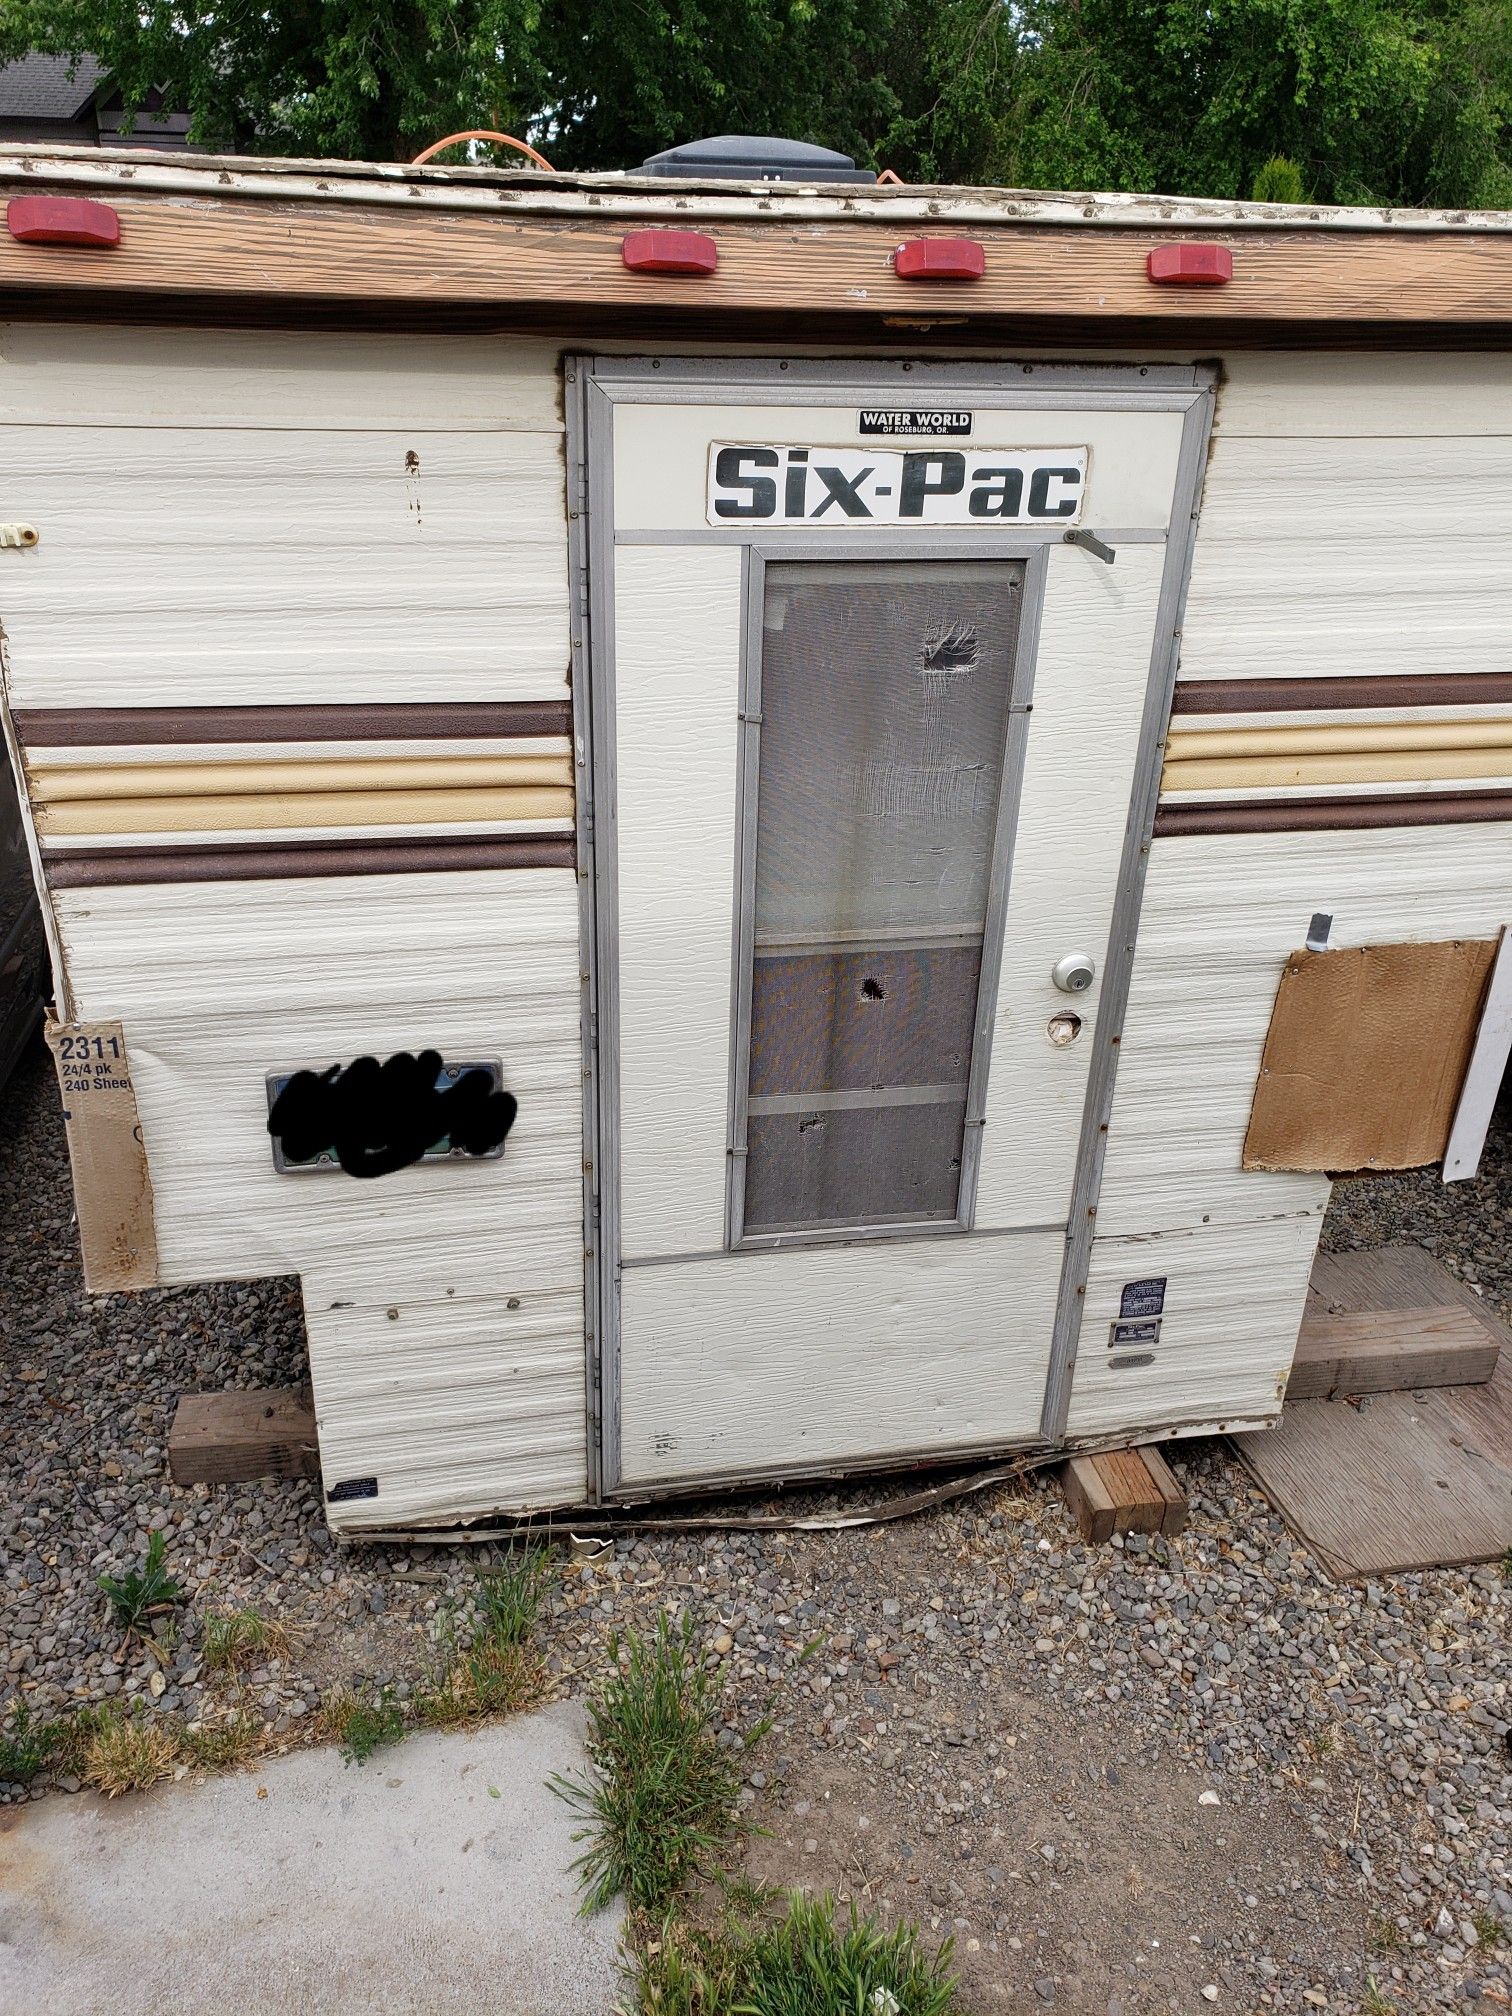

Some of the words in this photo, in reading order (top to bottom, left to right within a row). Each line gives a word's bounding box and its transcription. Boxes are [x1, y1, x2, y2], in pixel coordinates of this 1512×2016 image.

[863, 412, 911, 425] WATER
[916, 413, 970, 426] WORLD
[895, 426, 934, 434] ROSEBURG,
[937, 426, 949, 434] OR.
[714, 447, 1081, 518] Six-Pac
[60, 1036, 120, 1060] 2311
[62, 1063, 91, 1077] 24/4
[95, 1062, 112, 1076] pk
[65, 1080, 89, 1091] 240
